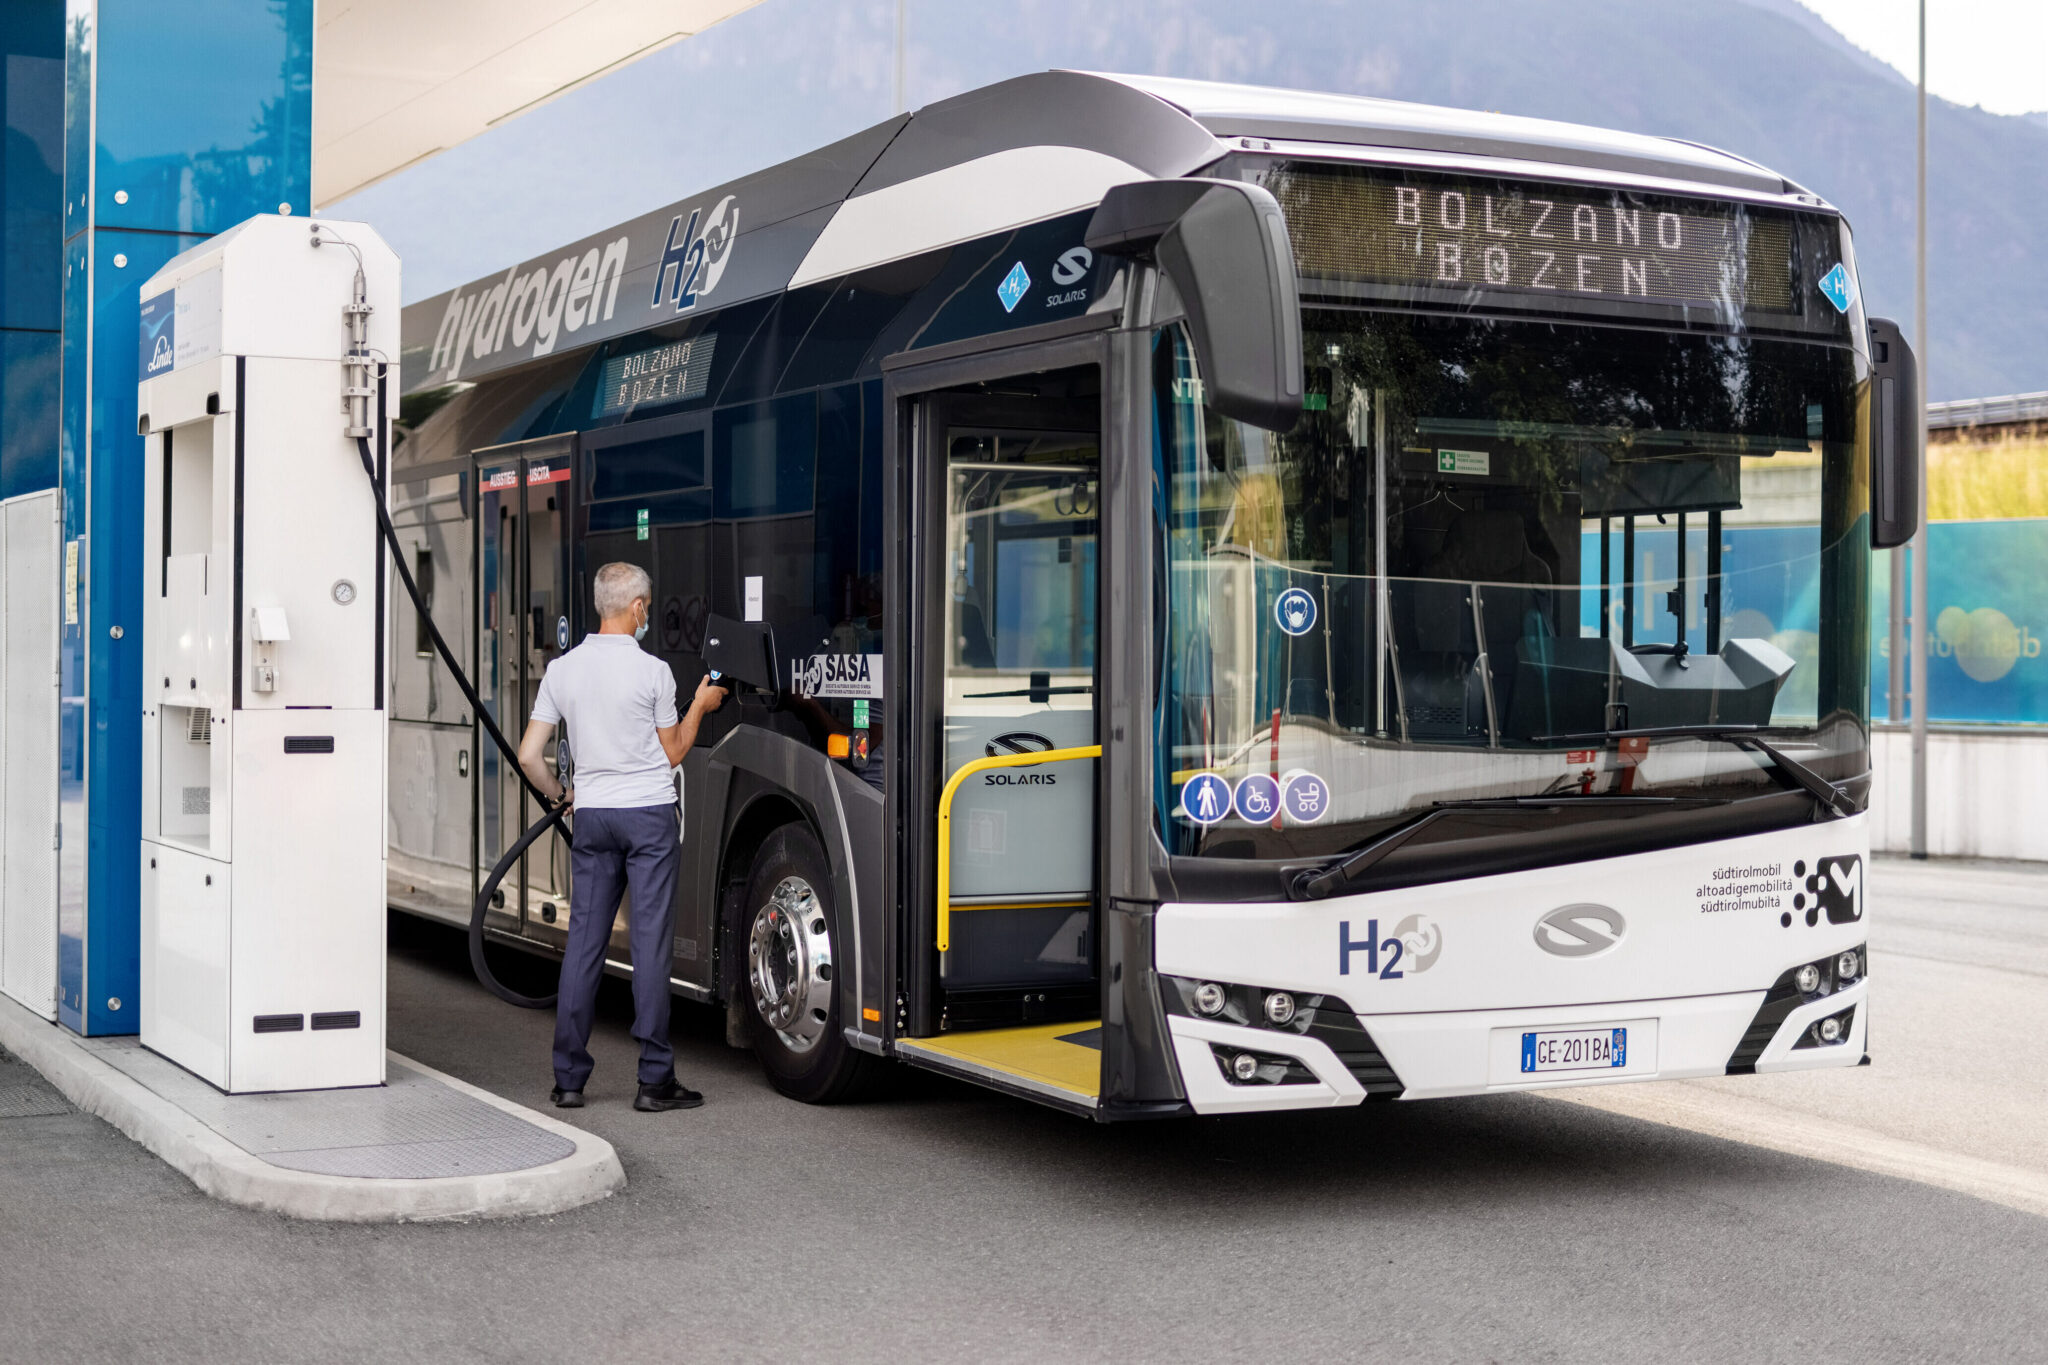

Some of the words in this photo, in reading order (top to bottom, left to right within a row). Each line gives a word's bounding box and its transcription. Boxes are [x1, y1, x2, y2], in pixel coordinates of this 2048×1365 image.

[1395, 187, 1681, 249] BOLZANO
[1436, 242, 1647, 296] BOZEN
[428, 235, 629, 382] hydrogen
[1046, 288, 1088, 308] SOLARIS
[147, 335, 173, 373] Linde
[622, 342, 692, 379] BOLZANO
[616, 369, 688, 406] BOZEN
[489, 470, 516, 489] AUSSTIEG
[529, 465, 550, 483] USCITA
[825, 654, 871, 681] SASA
[985, 774, 1056, 786] SOLARIS
[1712, 863, 1781, 880] südtirolmobil
[1696, 878, 1793, 898] altoadigemobilità
[1701, 895, 1781, 913] südtirolmubiltà
